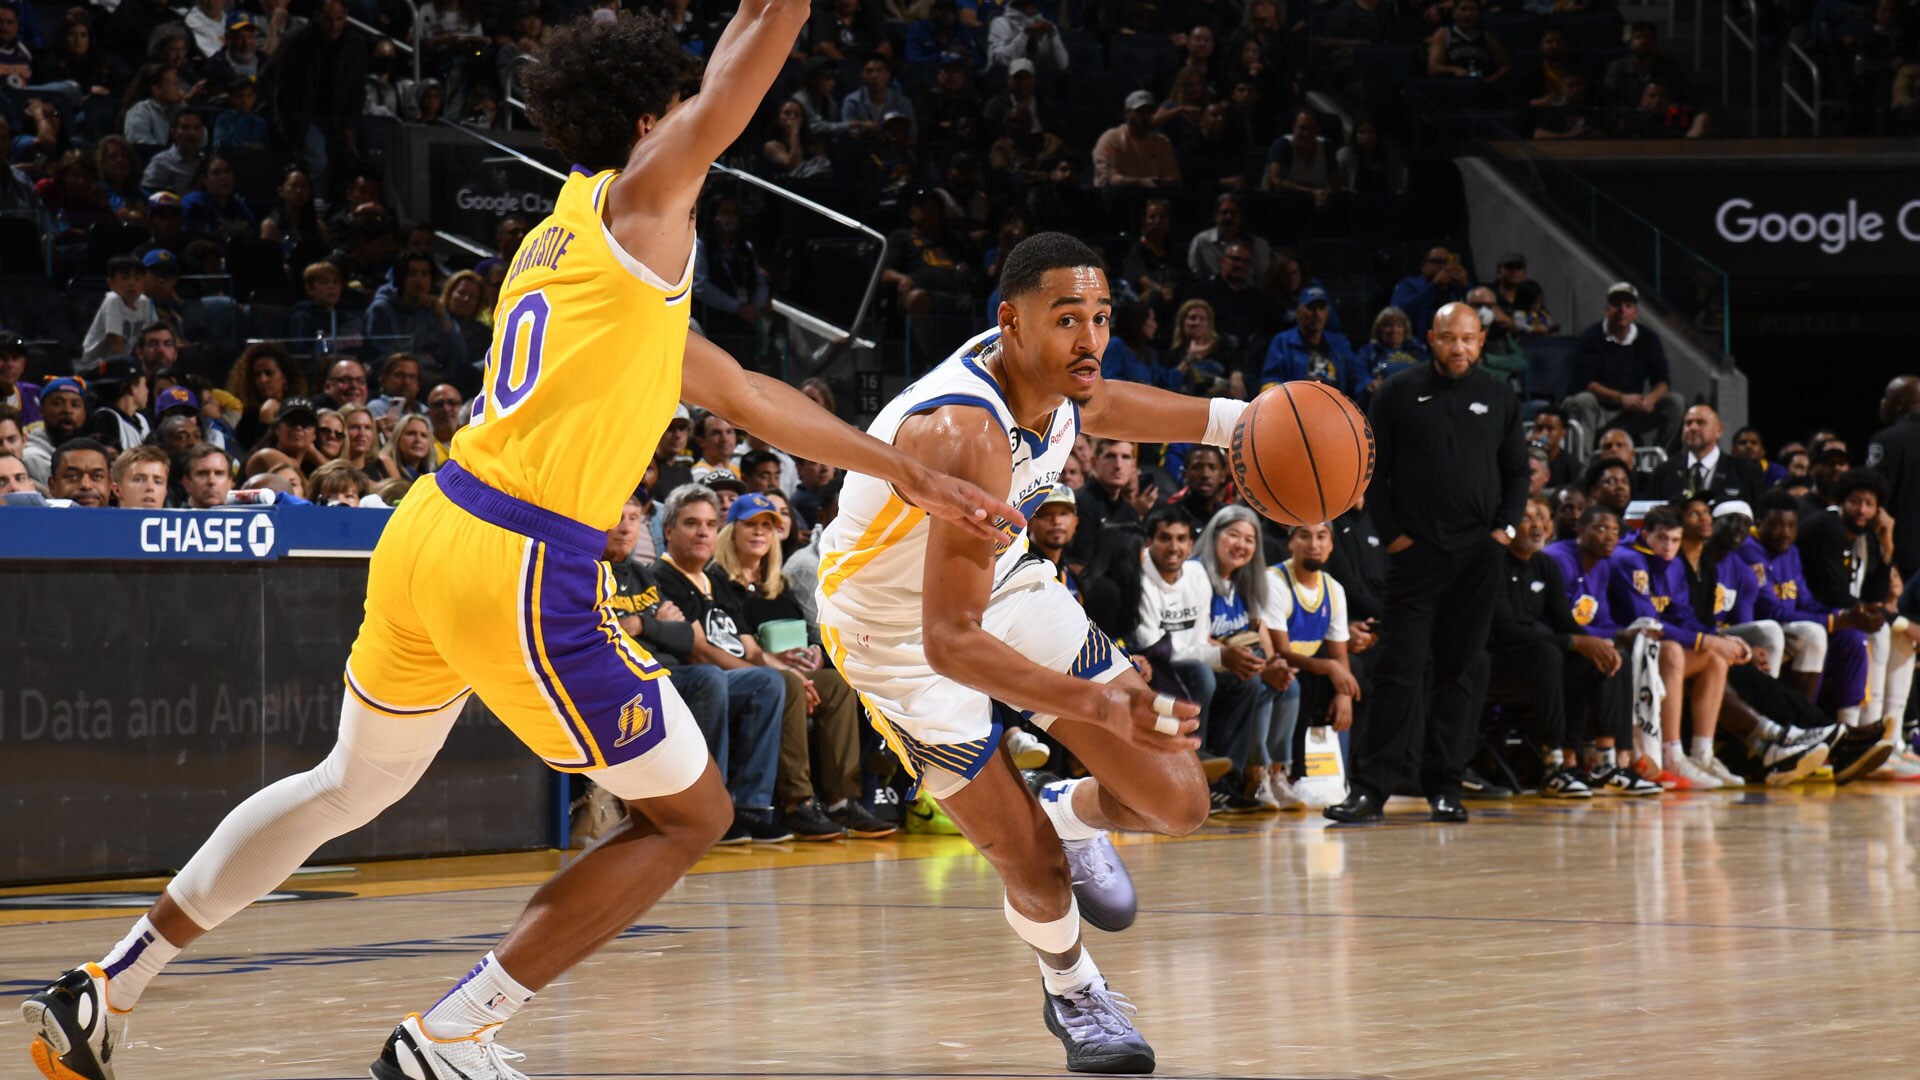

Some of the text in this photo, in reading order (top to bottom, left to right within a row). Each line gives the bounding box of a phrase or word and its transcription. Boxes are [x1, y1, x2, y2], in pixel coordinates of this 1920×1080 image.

[457, 189, 518, 216] Google
[1715, 198, 1884, 254] Google
[861, 374, 878, 389] 16
[861, 396, 878, 411] 15
[141, 517, 244, 553] CHASE
[20, 689, 113, 741] Data
[127, 684, 198, 738] and
